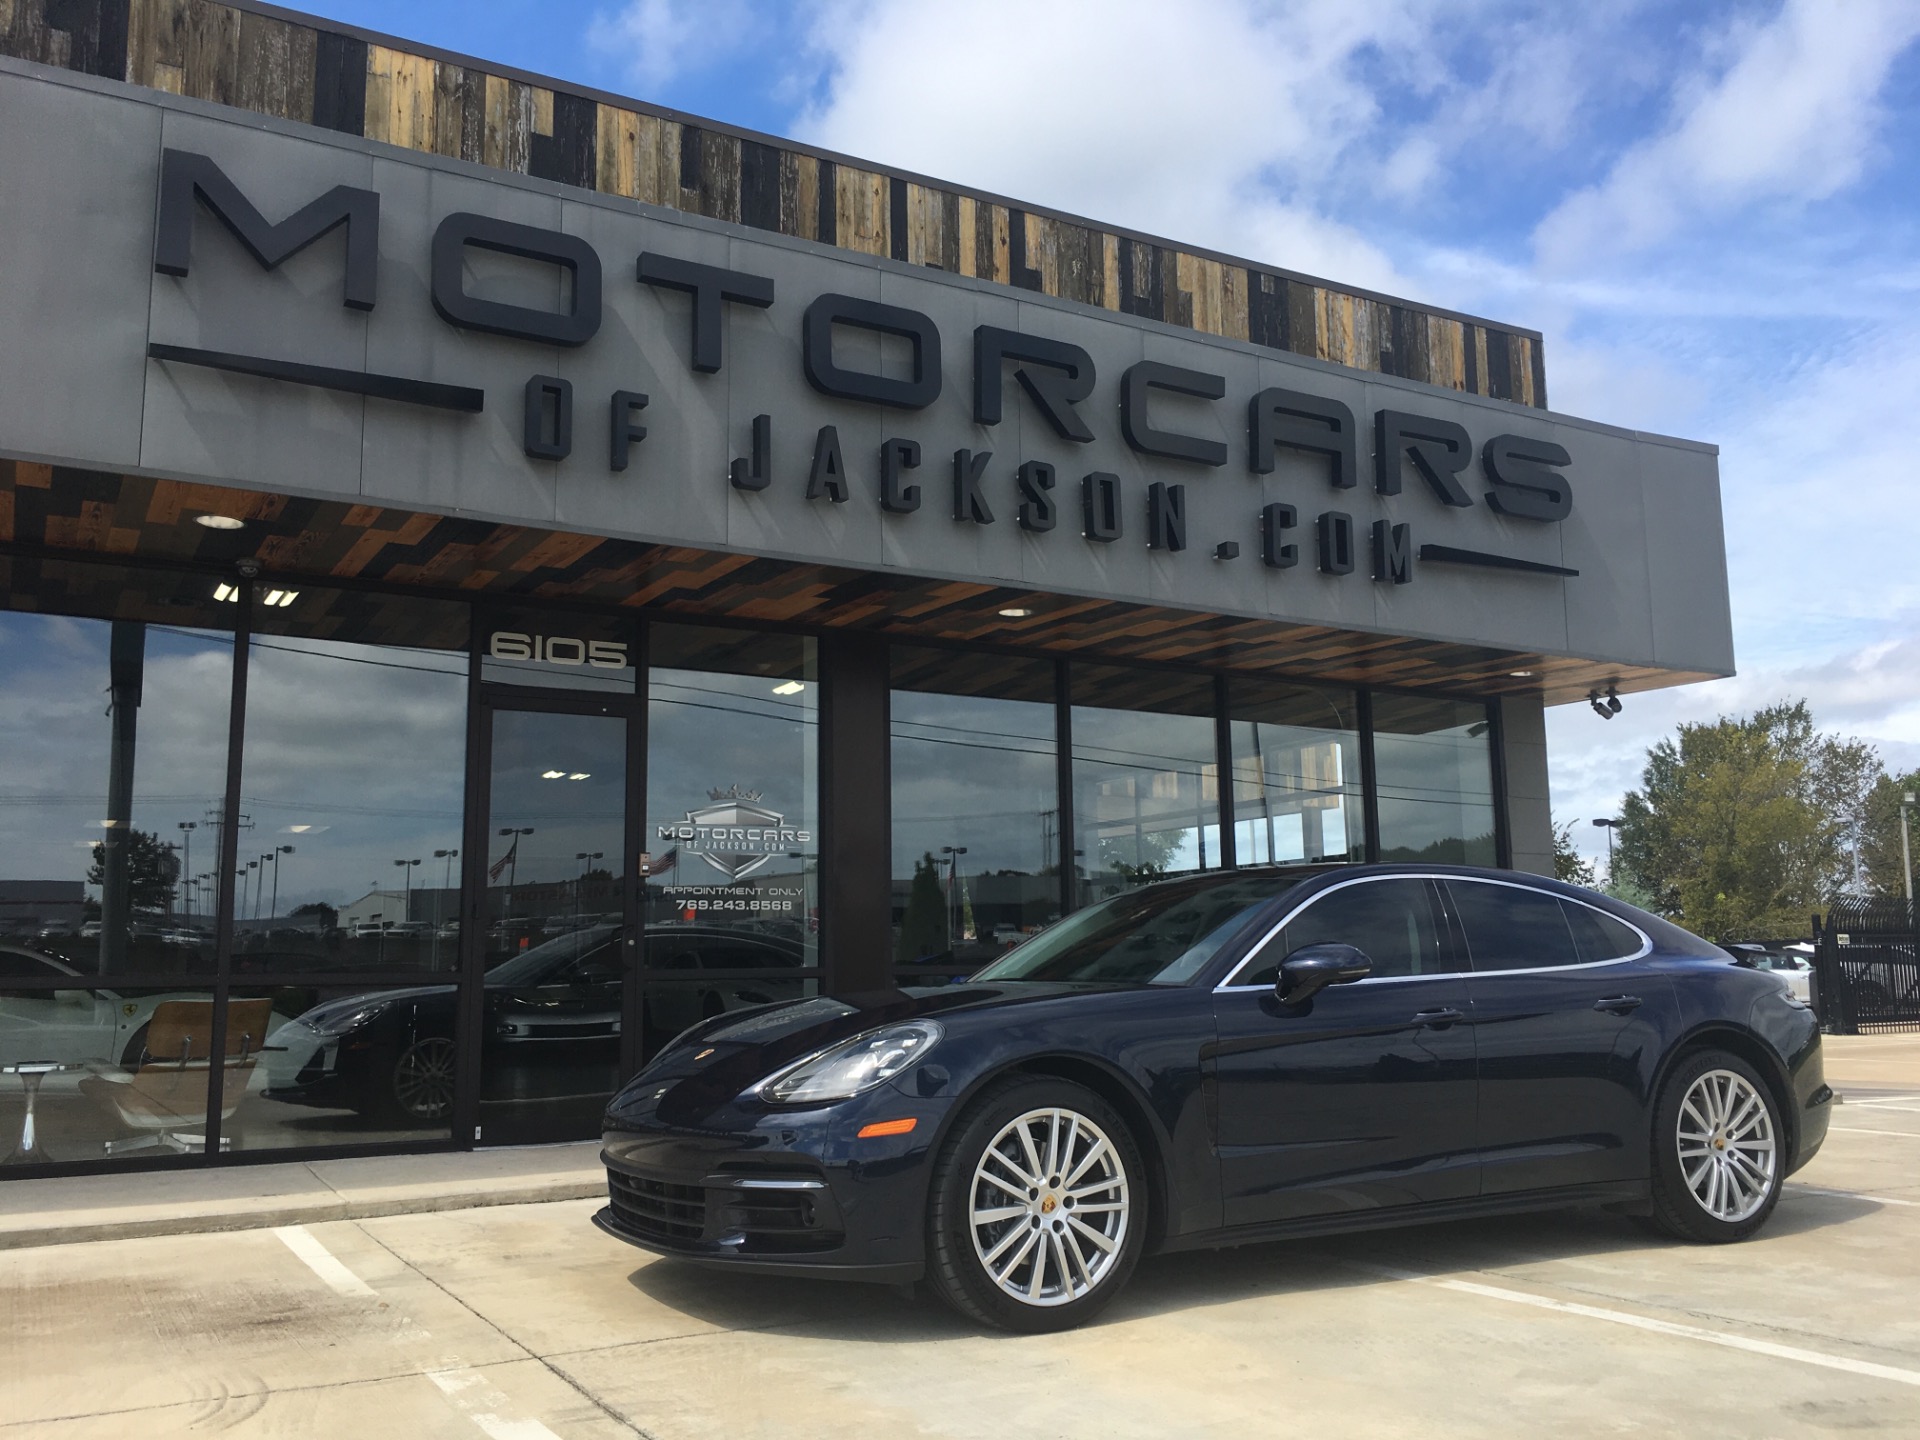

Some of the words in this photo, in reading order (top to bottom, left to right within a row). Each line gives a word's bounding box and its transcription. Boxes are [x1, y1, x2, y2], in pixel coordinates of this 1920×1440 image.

[154, 147, 1573, 522] MOTORCARS
[524, 374, 649, 472] OF
[490, 631, 628, 670] 6105
[657, 826, 811, 842] MOTORCARS
[686, 840, 698, 849] OF
[663, 887, 763, 896] APPOINTMENT
[768, 888, 804, 896] ONLY
[676, 899, 792, 911] 769.243.8568
